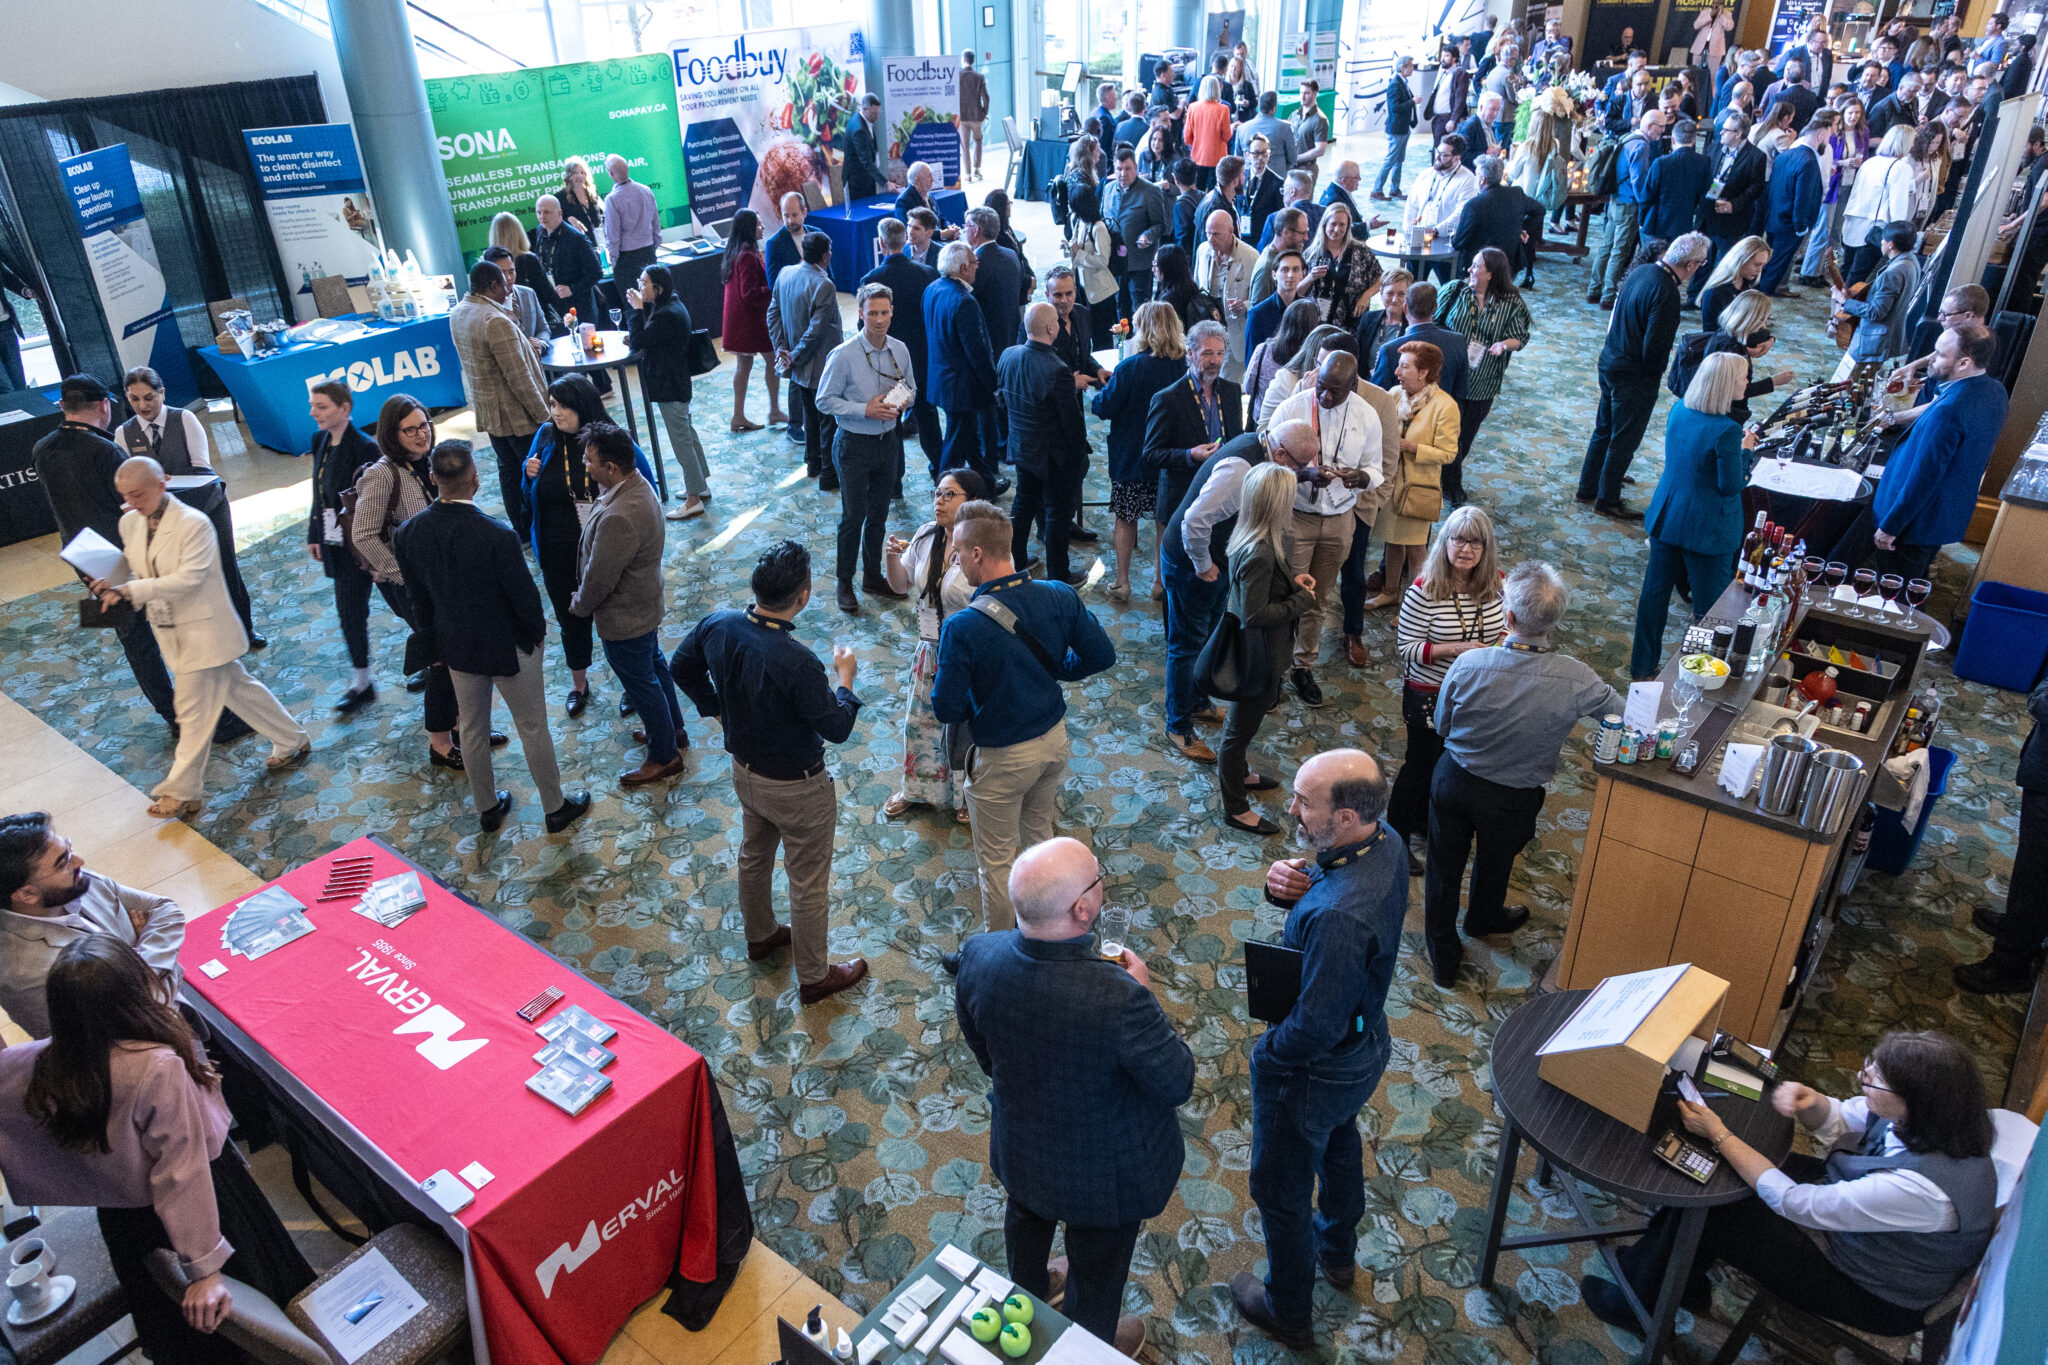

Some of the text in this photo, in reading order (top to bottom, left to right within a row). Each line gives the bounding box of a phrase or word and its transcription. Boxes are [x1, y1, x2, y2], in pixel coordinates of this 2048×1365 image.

[673, 34, 787, 87] Foodbuy
[887, 60, 956, 84] Foodbuy
[679, 84, 760, 102] SAVING YOU MONEY ON ALL
[608, 103, 668, 120] SONAPAY.CA
[681, 94, 758, 112] YOUR PROCUREMENT NEEDS
[251, 134, 293, 146] ECOLAB
[436, 127, 517, 161] SONA
[687, 133, 740, 149] Purchasing Optimization
[256, 150, 334, 163] The smarter way
[689, 154, 700, 163] Best
[705, 151, 718, 159] Class
[718, 145, 747, 157] Procurement
[66, 161, 94, 177] ECOLAB
[260, 159, 342, 173] to clean, disinfect
[691, 159, 741, 176] Contract Management
[263, 170, 316, 183] and refresh
[446, 167, 513, 188] SEAMLESS
[450, 179, 526, 201] UNMATCHED
[627, 157, 648, 168] AIR,
[693, 174, 737, 189] Flexible Distribution
[73, 181, 101, 195] Clean up
[694, 186, 742, 202] Professional Services
[77, 188, 114, 209] your laundry
[451, 187, 544, 214] TRANSPARENT
[80, 201, 113, 218] operations
[696, 200, 737, 215] Culinary Solutions
[0, 467, 40, 490] TIS
[371, 938, 417, 970] Since 1985
[645, 1200, 668, 1221] Since
